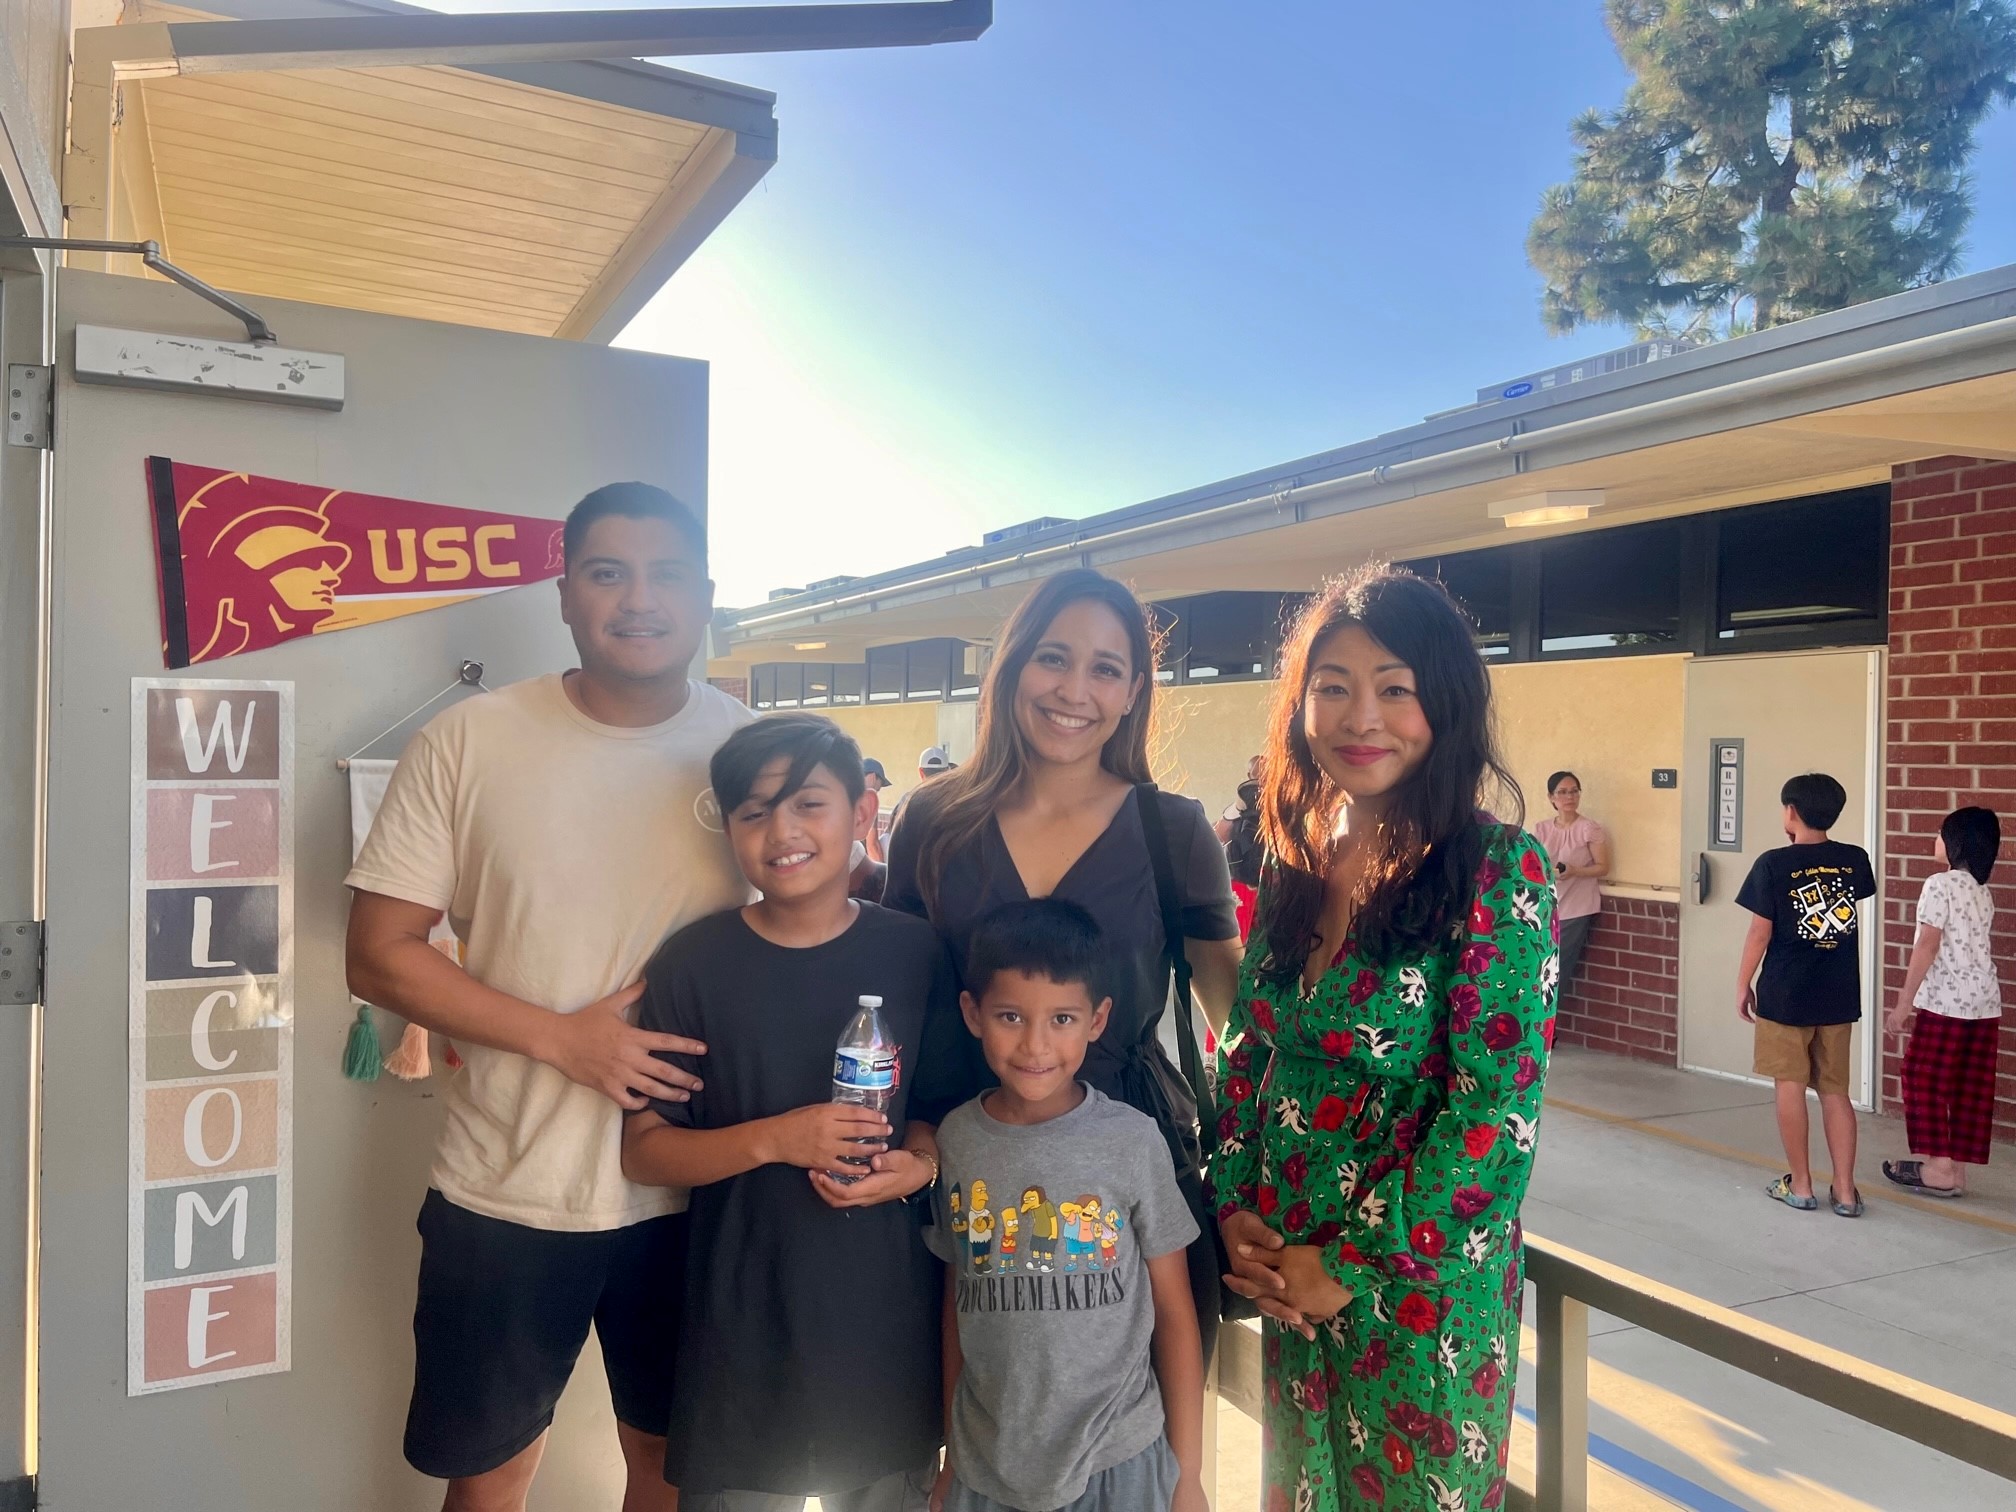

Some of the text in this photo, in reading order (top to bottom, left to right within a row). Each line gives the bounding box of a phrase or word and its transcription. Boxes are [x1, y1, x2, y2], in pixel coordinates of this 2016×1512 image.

[367, 524, 521, 584] USC
[1658, 772, 1669, 782] 33
[174, 697, 256, 1369] WELCOME
